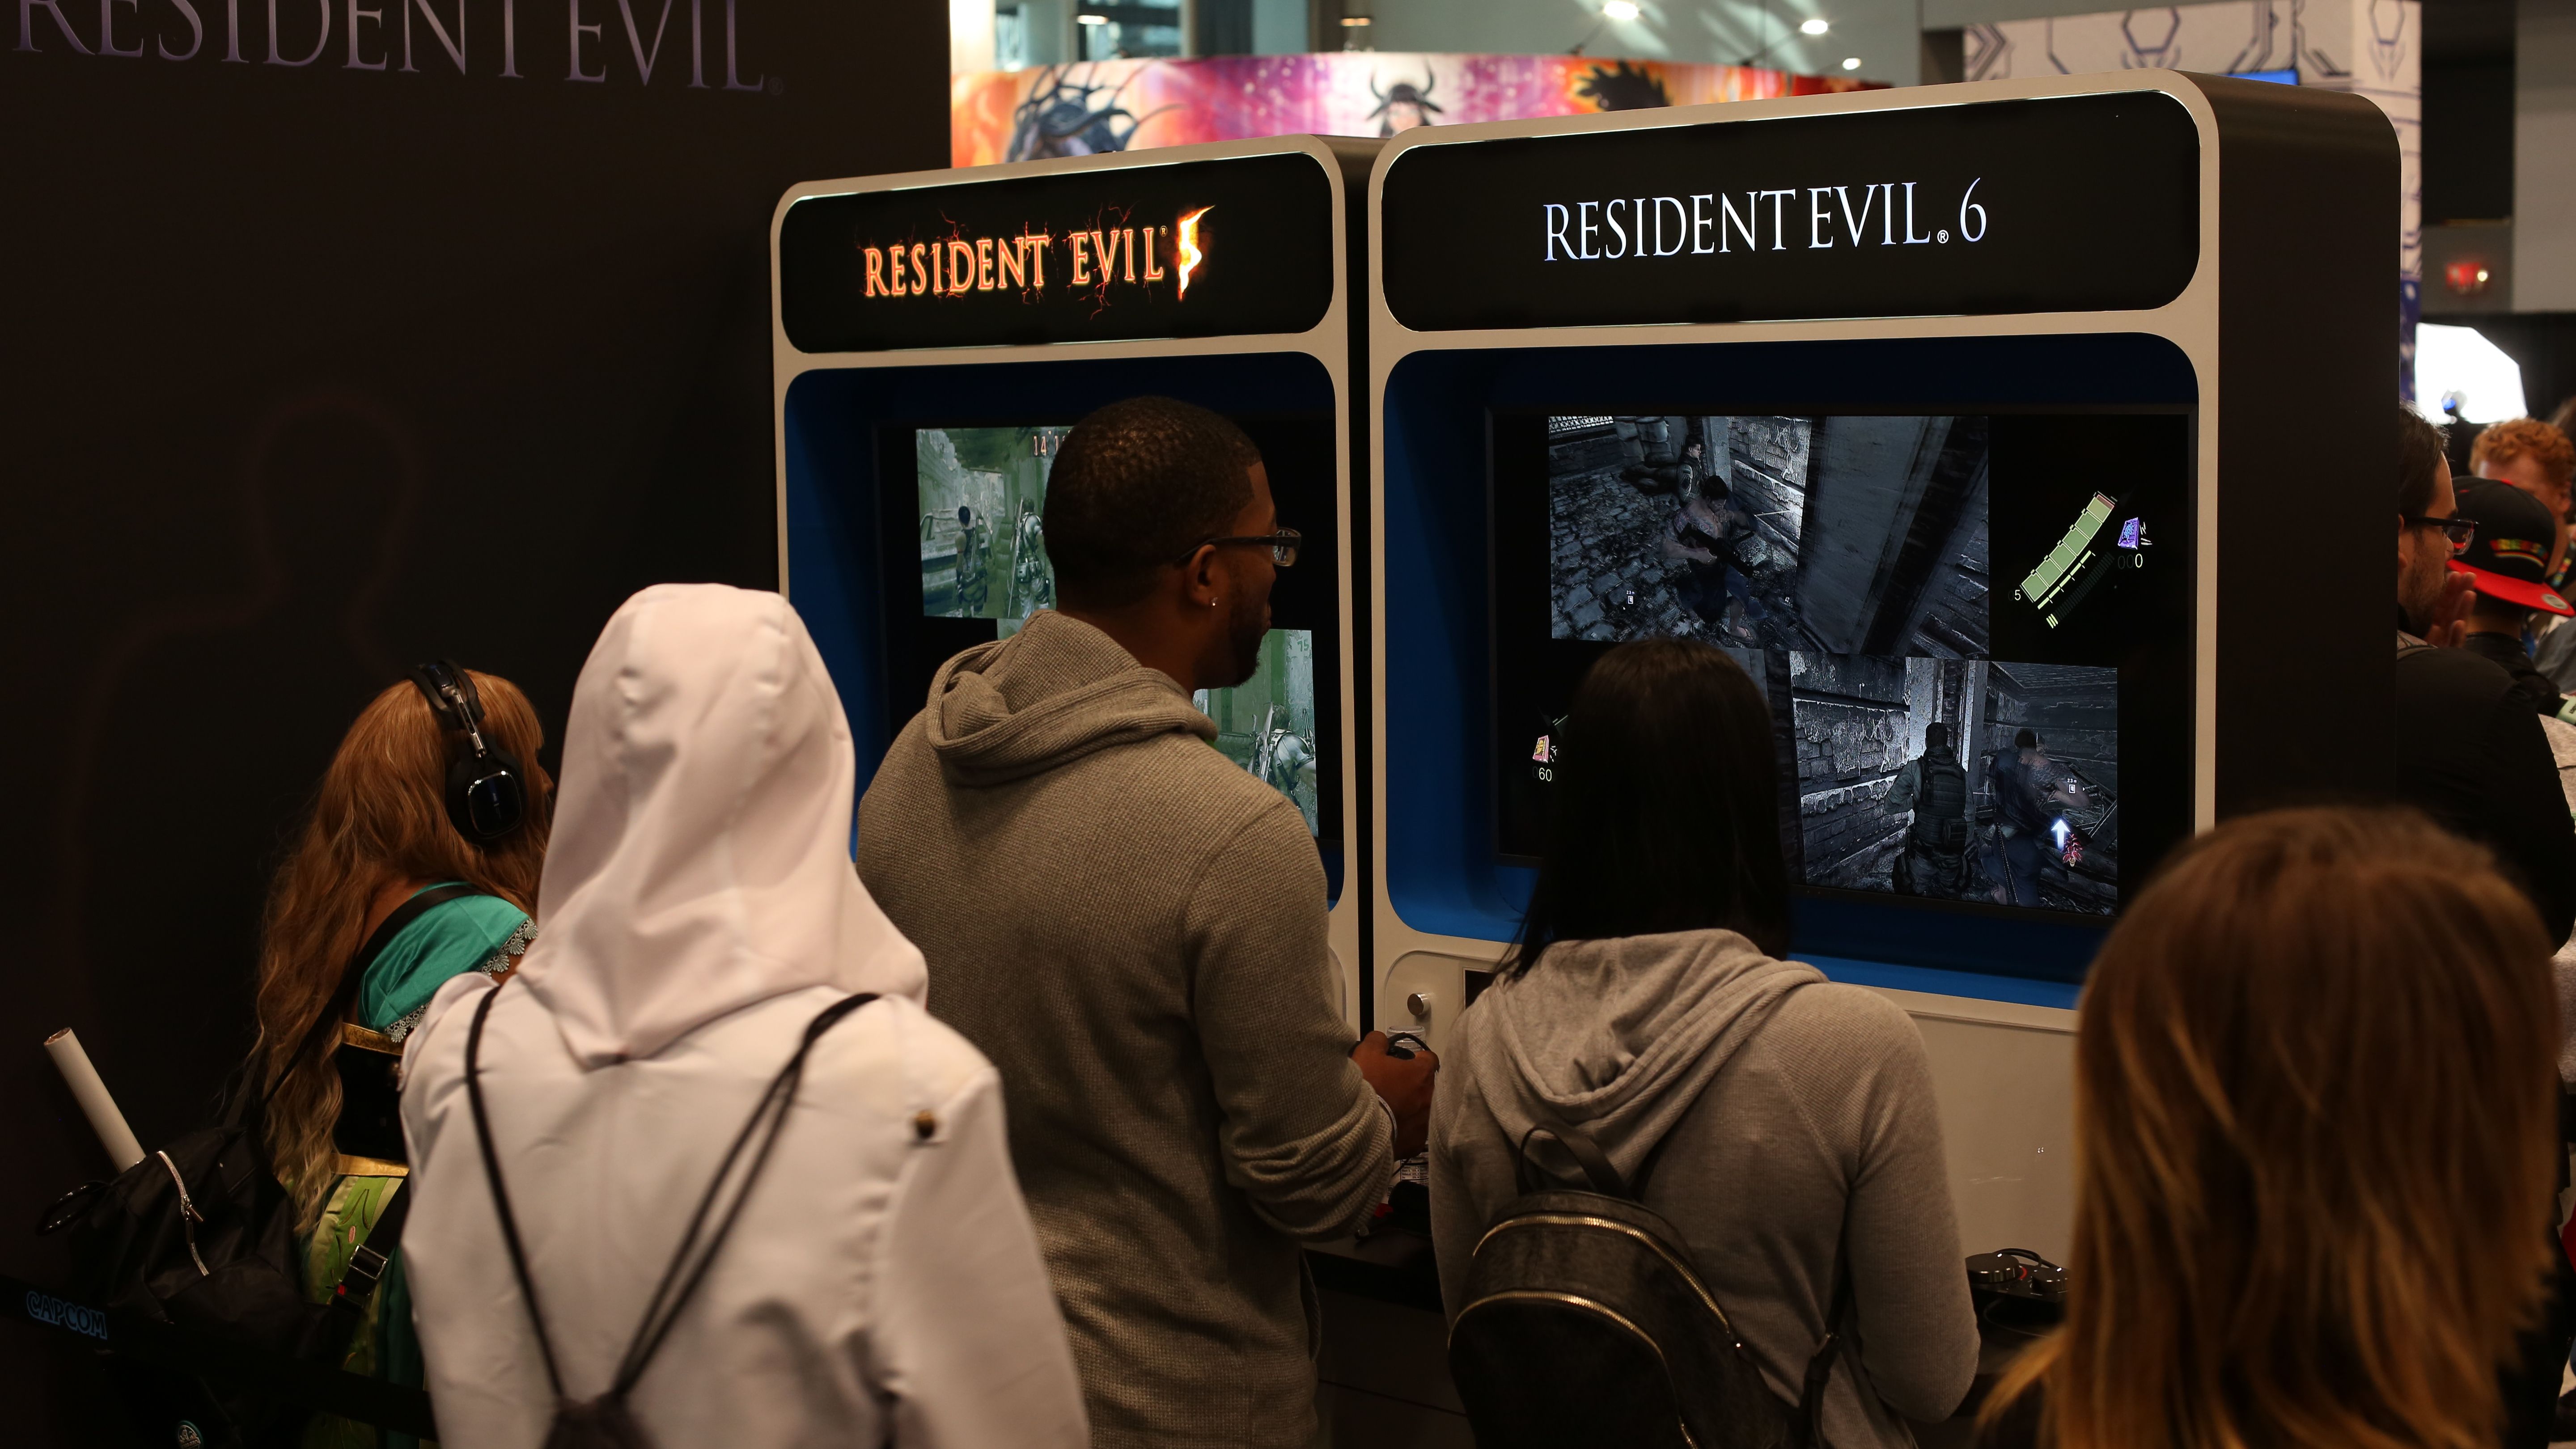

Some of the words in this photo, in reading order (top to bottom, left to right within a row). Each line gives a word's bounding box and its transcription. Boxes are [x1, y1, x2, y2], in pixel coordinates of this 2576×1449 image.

[1543, 187, 1796, 261] RESIDENT
[1959, 177, 1987, 242] 6
[864, 234, 1050, 298] RESIDENT
[26, 1290, 107, 1340] CAPCOM
